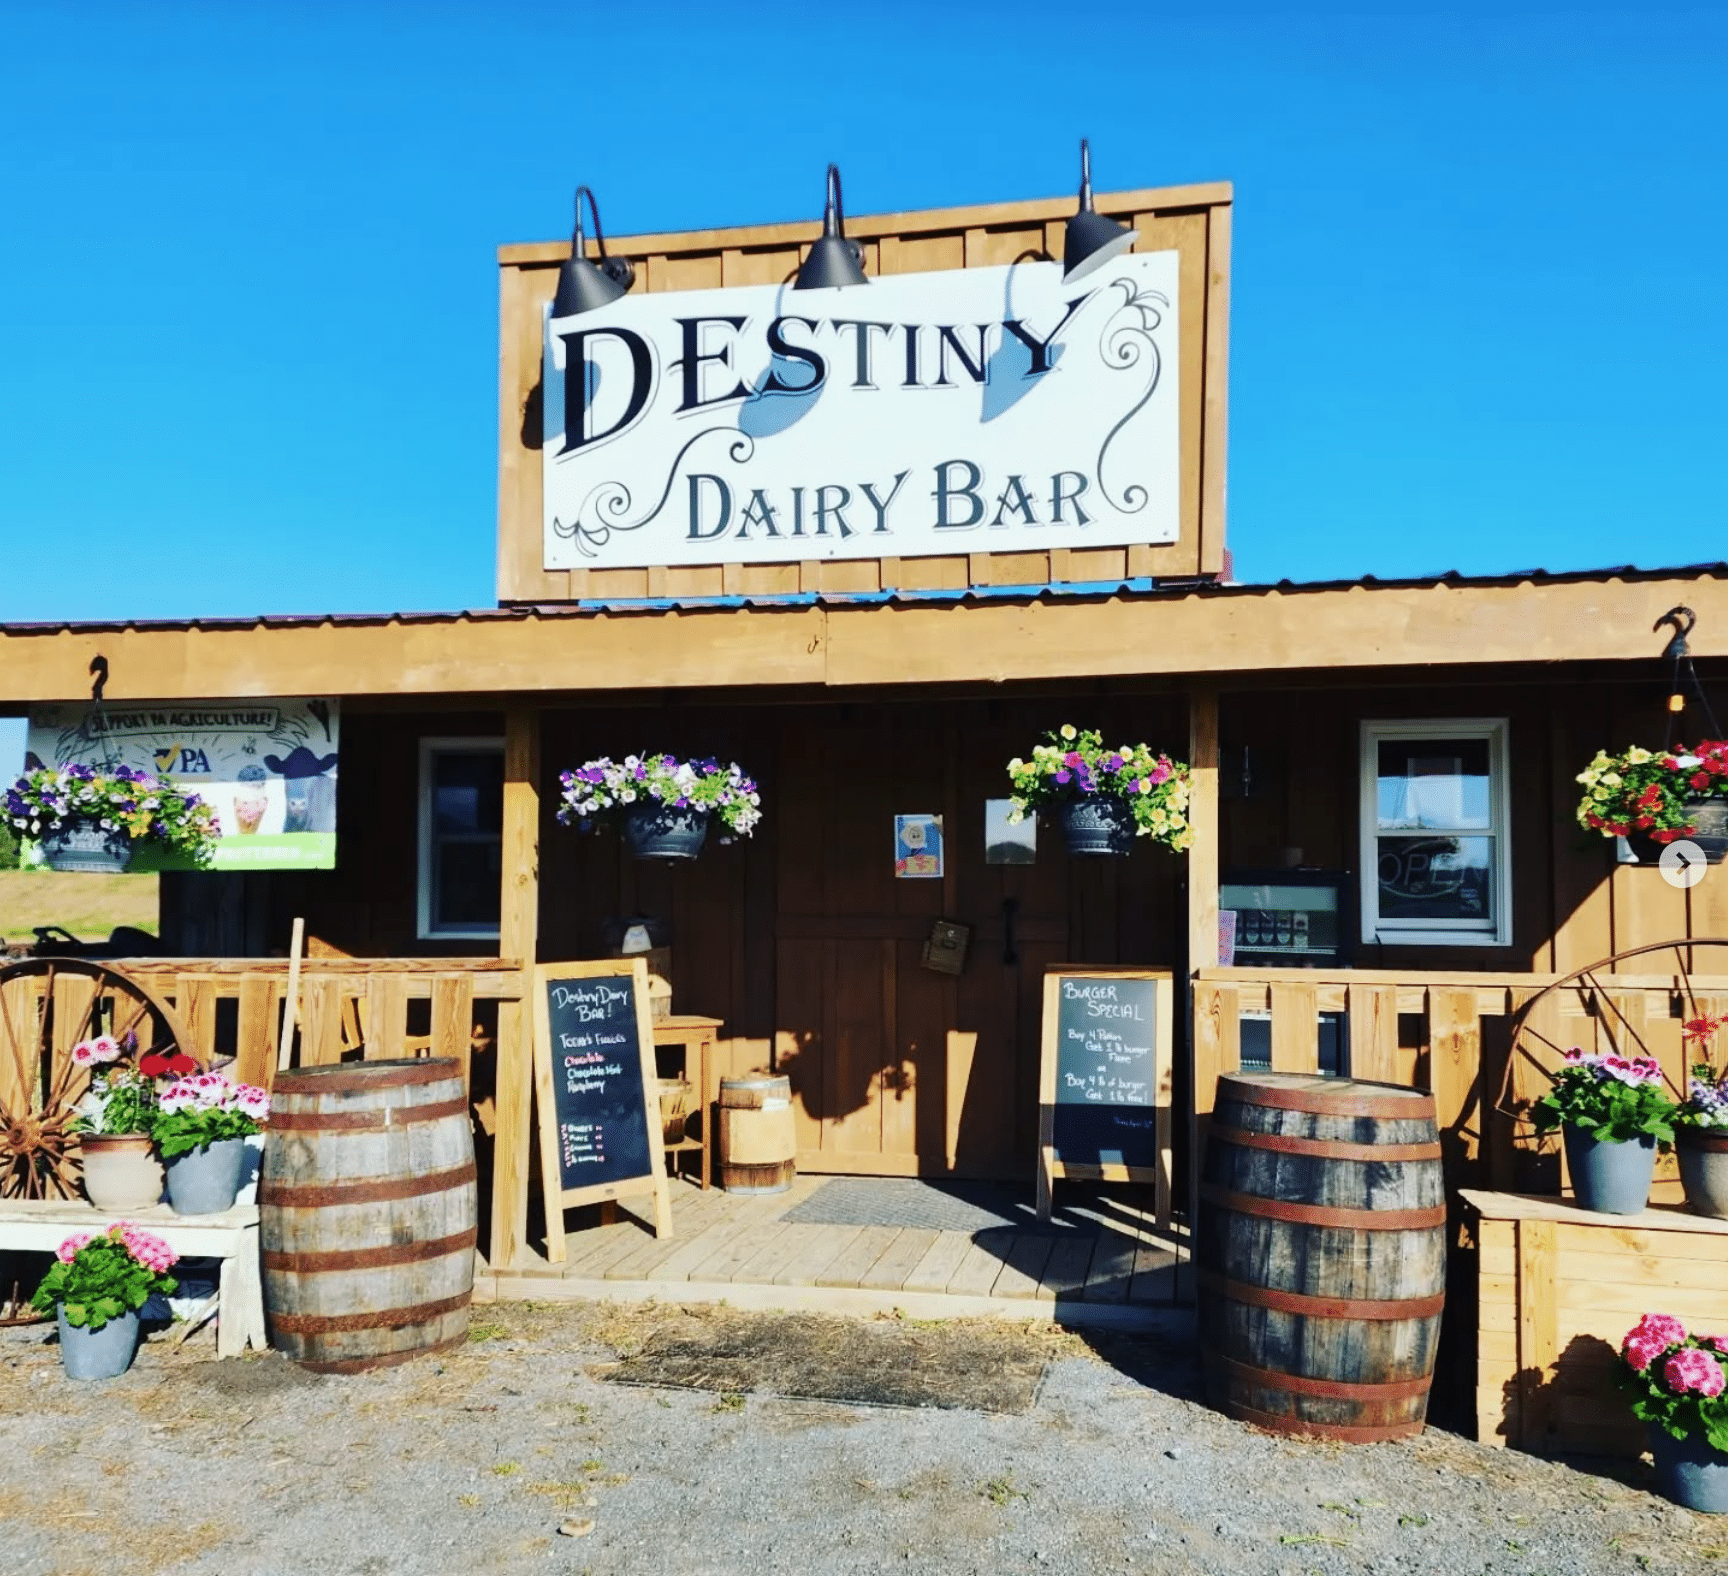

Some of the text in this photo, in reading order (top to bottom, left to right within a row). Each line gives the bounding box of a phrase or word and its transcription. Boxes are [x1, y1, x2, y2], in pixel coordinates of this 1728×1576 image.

[555, 286, 1099, 463] DESTINY
[685, 459, 1097, 542] DAIRY BAR
[92, 712, 272, 732] SUPPORT PA AGRICULTURE!
[180, 748, 212, 773] PA
[1063, 982, 1118, 1002] BURGER
[1087, 1000, 1145, 1022] SPECIAL
[1068, 1028, 1085, 1042] Buy
[1085, 1041, 1103, 1052] Get
[1064, 1072, 1086, 1089] Buy
[1085, 1088, 1103, 1100] Get
